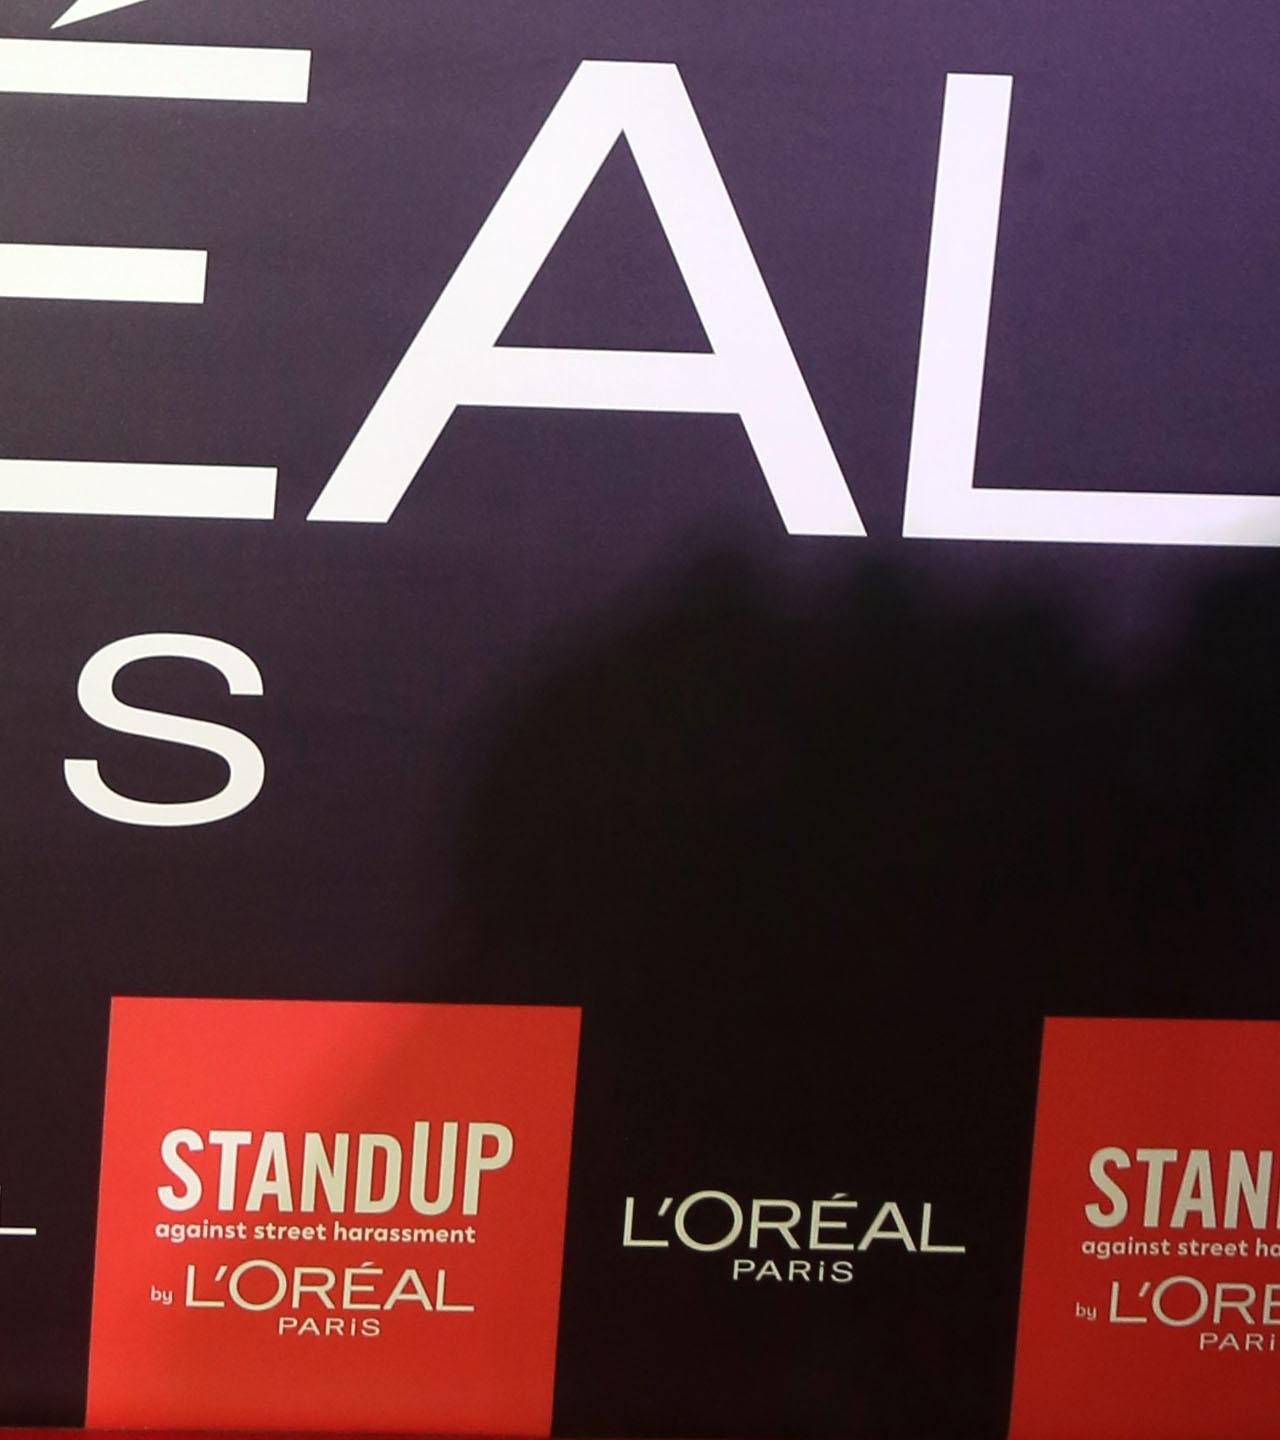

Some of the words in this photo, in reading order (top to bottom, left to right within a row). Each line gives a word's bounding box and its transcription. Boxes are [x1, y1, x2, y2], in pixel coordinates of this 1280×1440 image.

[156, 1120, 515, 1217] STANDUP
[1083, 1145, 1280, 1231] STAN
[154, 1217, 248, 1245] against
[252, 1221, 328, 1242] street
[332, 1219, 477, 1245] harassment
[621, 1189, 967, 1254] L'ORÉAL
[1080, 1235, 1172, 1261] against
[1176, 1238, 1250, 1258] street
[149, 1284, 174, 1307] by
[184, 1258, 476, 1313] L'ORÉAL
[1074, 1300, 1098, 1322] by
